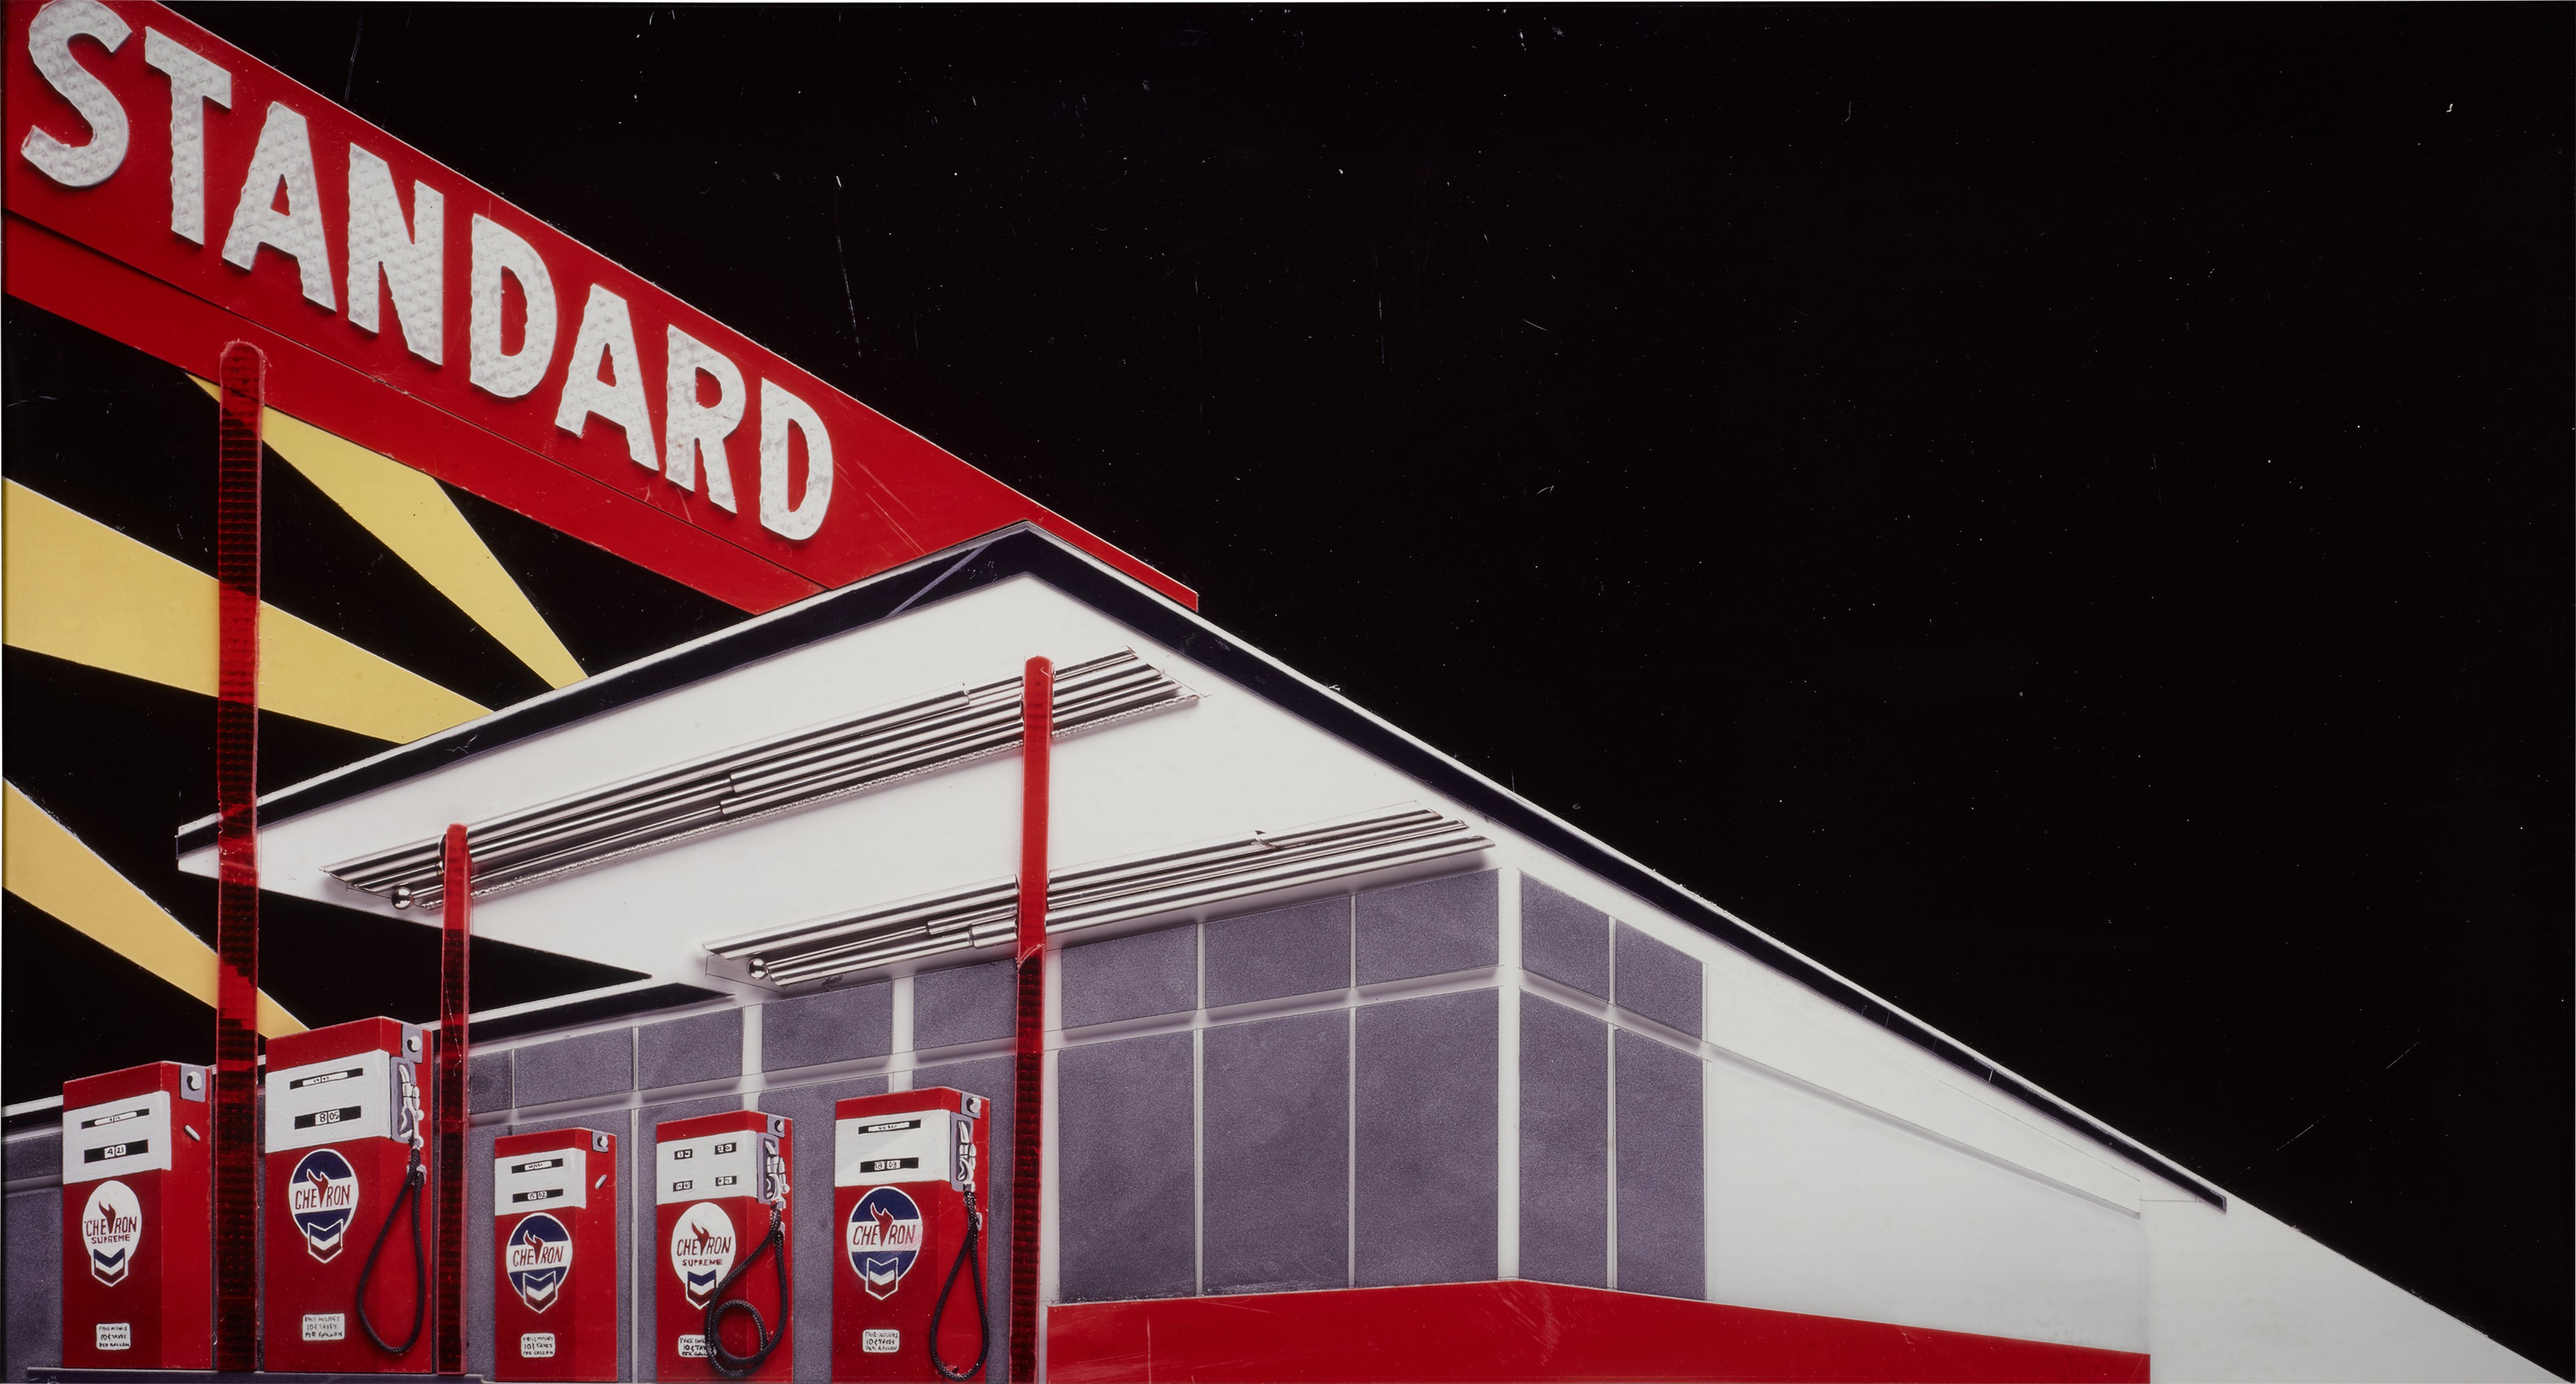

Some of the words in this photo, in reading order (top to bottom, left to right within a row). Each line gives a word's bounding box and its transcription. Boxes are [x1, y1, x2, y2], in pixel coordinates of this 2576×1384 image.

[21, 0, 835, 541] STANDARD
[295, 1179, 350, 1210] CHEVRON
[85, 1212, 137, 1236] CHEVRON
[853, 1218, 915, 1246] CHEVRON
[92, 1234, 130, 1243] SUPREME
[677, 1232, 731, 1256] CHEVRON
[513, 1241, 563, 1266] CHEVRON
